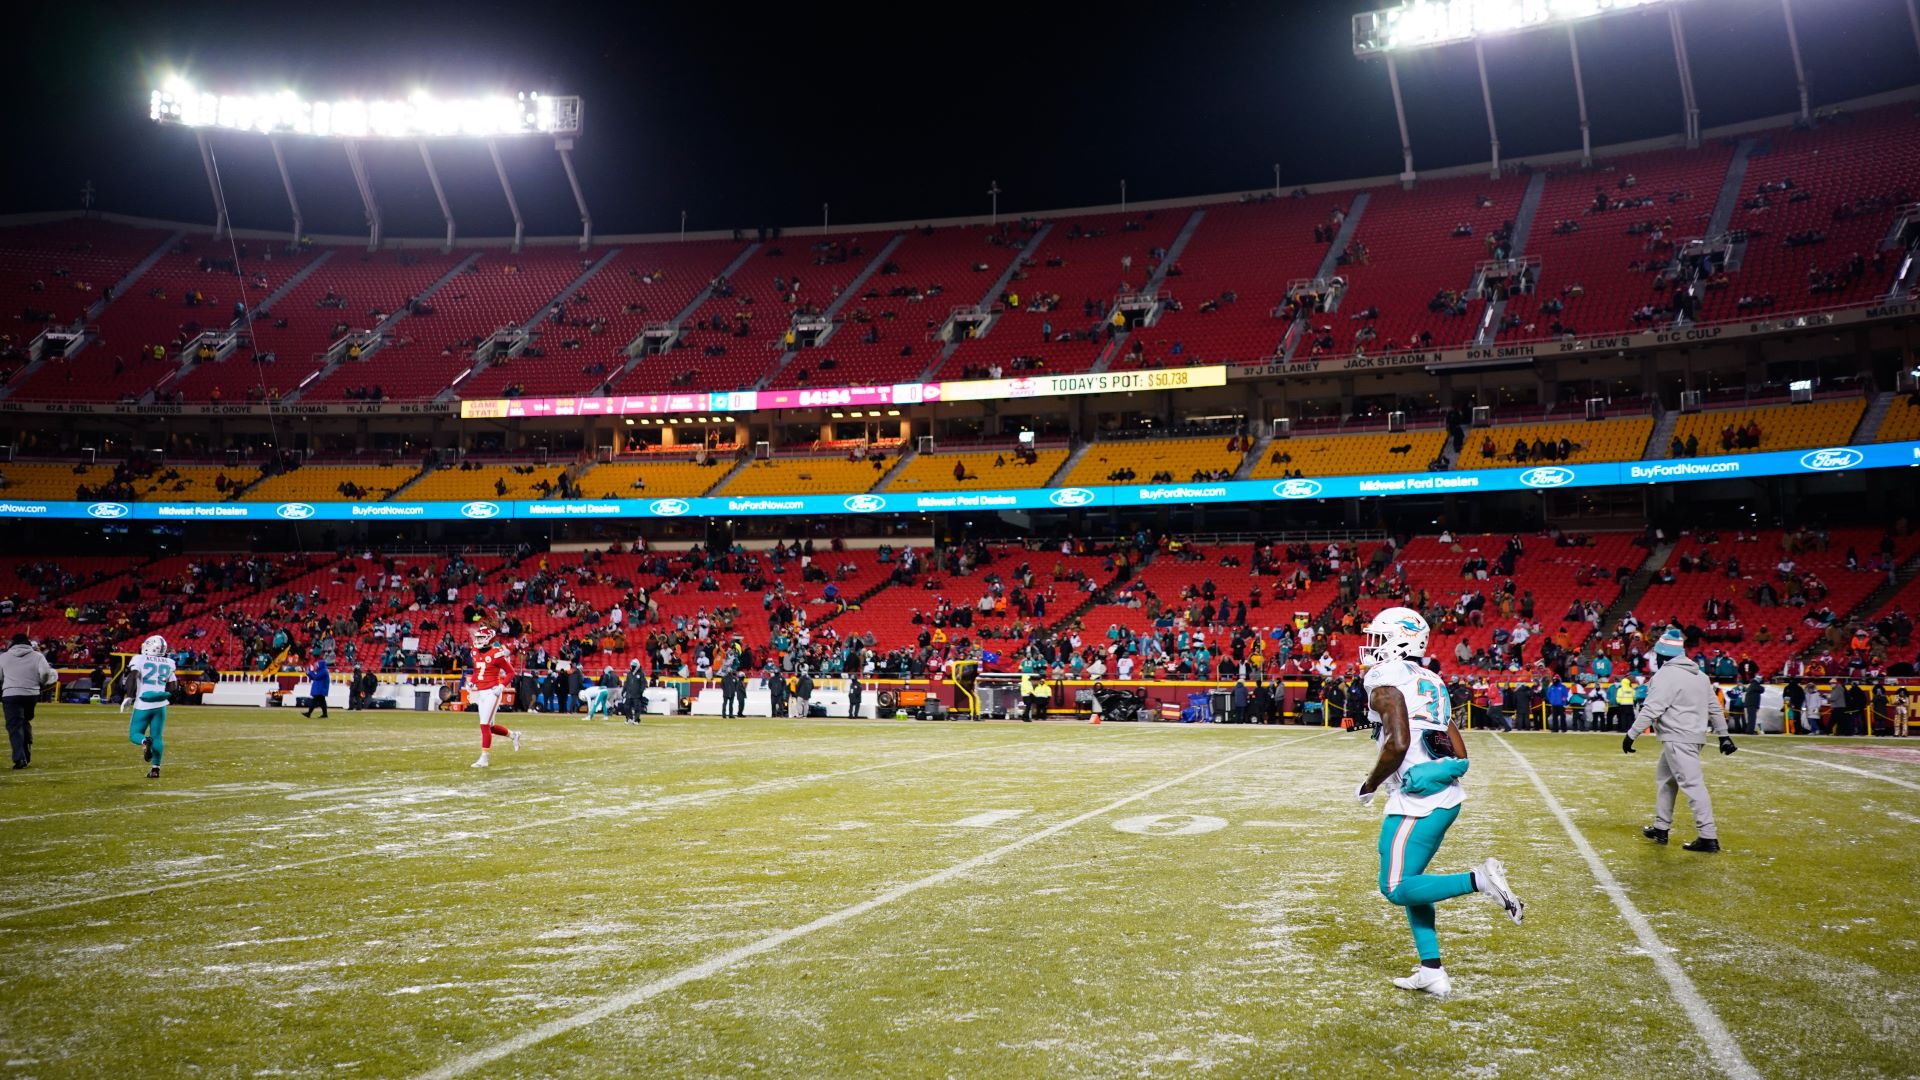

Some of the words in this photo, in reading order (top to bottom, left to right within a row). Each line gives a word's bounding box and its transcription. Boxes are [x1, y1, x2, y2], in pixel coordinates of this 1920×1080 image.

[1686, 328, 1721, 339] CULP
[1590, 336, 1630, 349] LEWS
[1496, 346, 1534, 358] SMITH
[1344, 358, 1374, 368] JACK
[1377, 353, 1442, 366] STEADMN
[1268, 362, 1320, 374] DELANEY
[1052, 376, 1107, 392] TODAY'S
[1112, 374, 1144, 388] POT:
[800, 390, 850, 405] 54:24
[1631, 461, 1739, 478] BuyFordNow.com
[1360, 480, 1406, 491] Midwest
[1407, 478, 1434, 489] Ford
[1435, 476, 1479, 488] Dealers
[1140, 487, 1226, 500] BuyFordNow.com
[729, 500, 804, 510] BuyFordNow.com
[917, 497, 956, 507] Midwest
[957, 496, 979, 506] Ford
[980, 496, 1016, 506] Dealers
[159, 506, 194, 515] Midwest
[195, 506, 214, 515] Ford
[216, 506, 248, 515] Dealers
[352, 506, 424, 516] BuyFordNow.com
[530, 504, 565, 514] Midwest
[566, 504, 586, 513] Ford
[588, 504, 620, 513] Dealers
[142, 662, 172, 686] 28
[476, 662, 486, 680] 7
